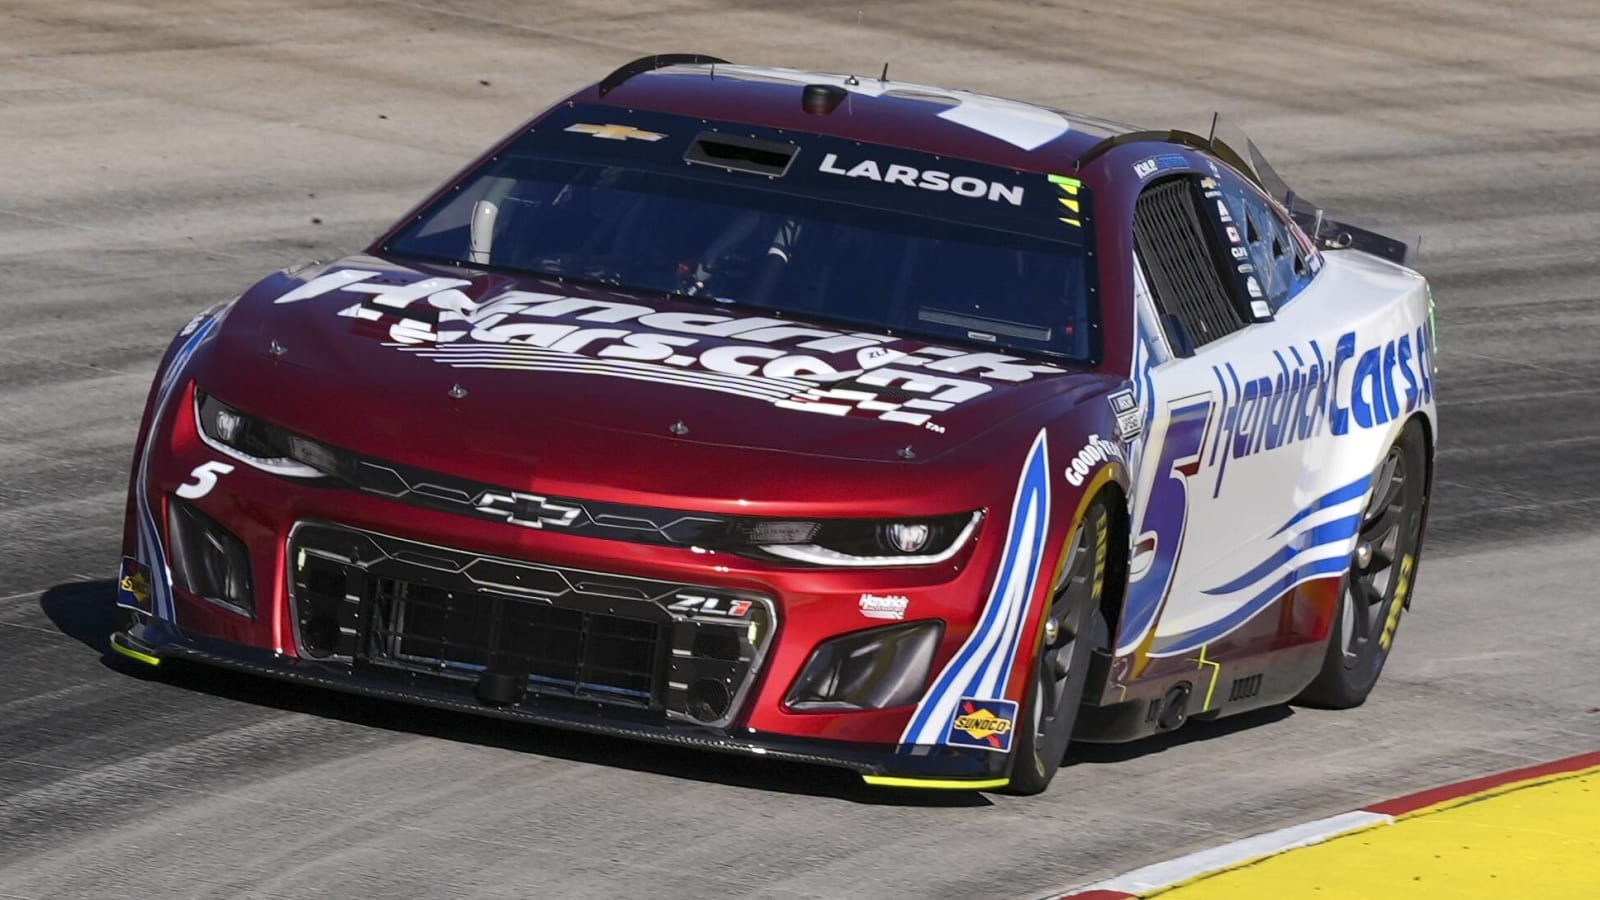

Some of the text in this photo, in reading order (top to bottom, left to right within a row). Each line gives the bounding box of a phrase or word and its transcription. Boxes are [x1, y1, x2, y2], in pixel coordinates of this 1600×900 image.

[818, 153, 1025, 206] LARSON
[926, 421, 946, 434] TM
[175, 460, 235, 499] 5
[1113, 391, 1214, 657] 5
[667, 594, 753, 617] ZL1
[858, 593, 909, 611] Hendrick
[955, 716, 1007, 733] SUNOCO
